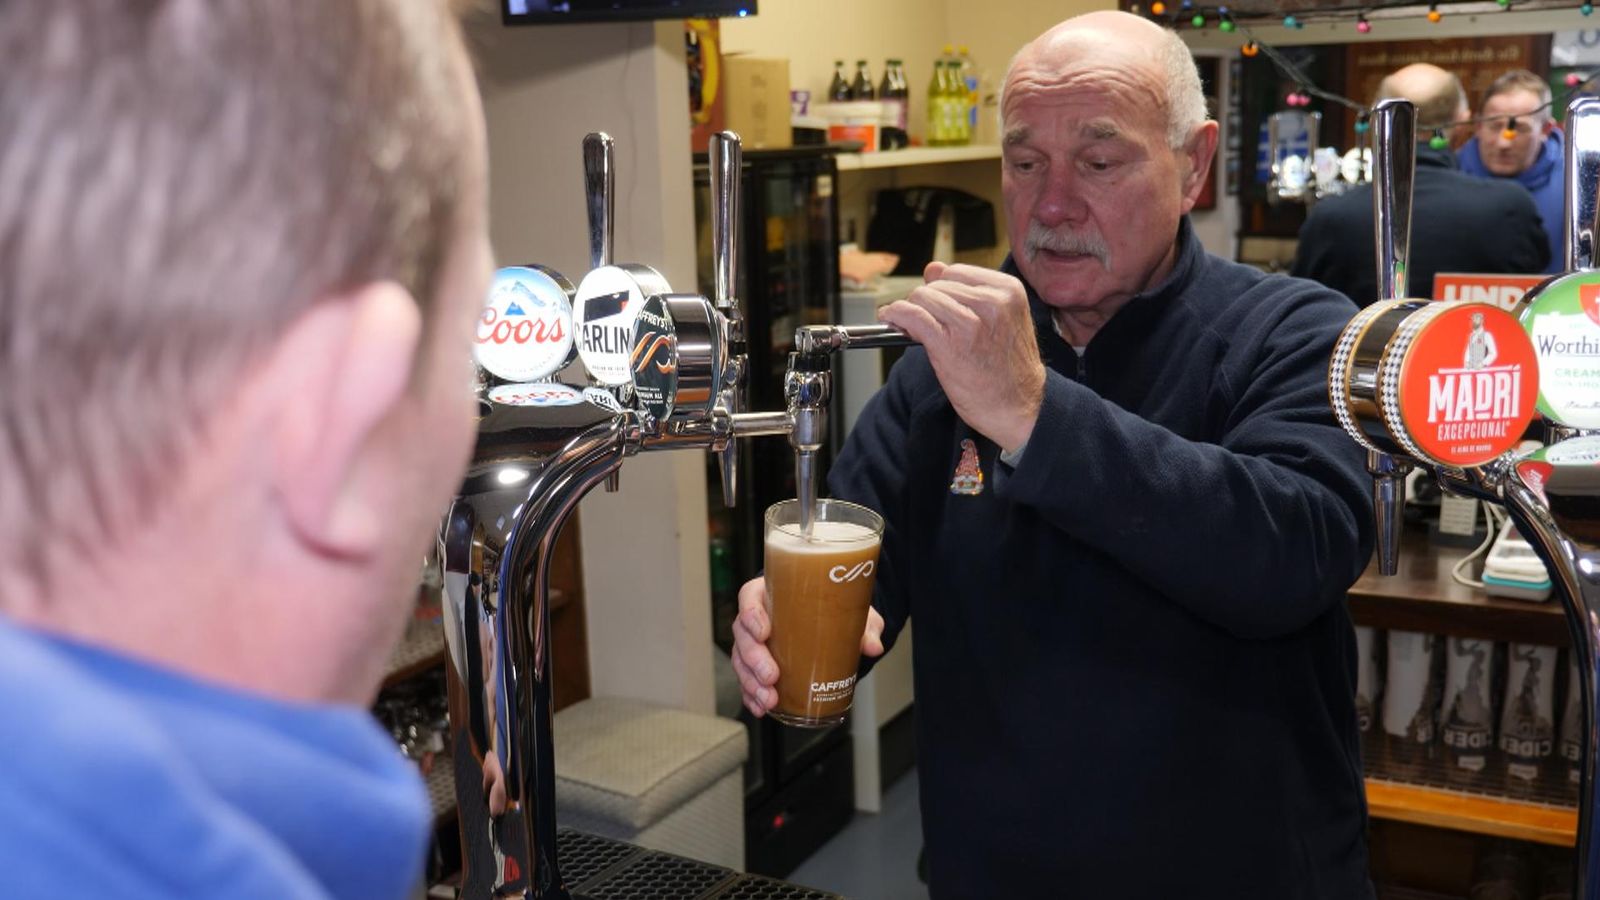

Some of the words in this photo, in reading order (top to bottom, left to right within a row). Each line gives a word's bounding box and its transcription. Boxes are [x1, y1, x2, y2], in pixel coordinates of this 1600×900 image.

[1444, 284, 1532, 311] UND
[474, 306, 566, 345] Coors
[574, 322, 630, 354] CARLIN
[1537, 334, 1600, 357] Worthi
[1437, 421, 1507, 441] EXCEPCIONAL
